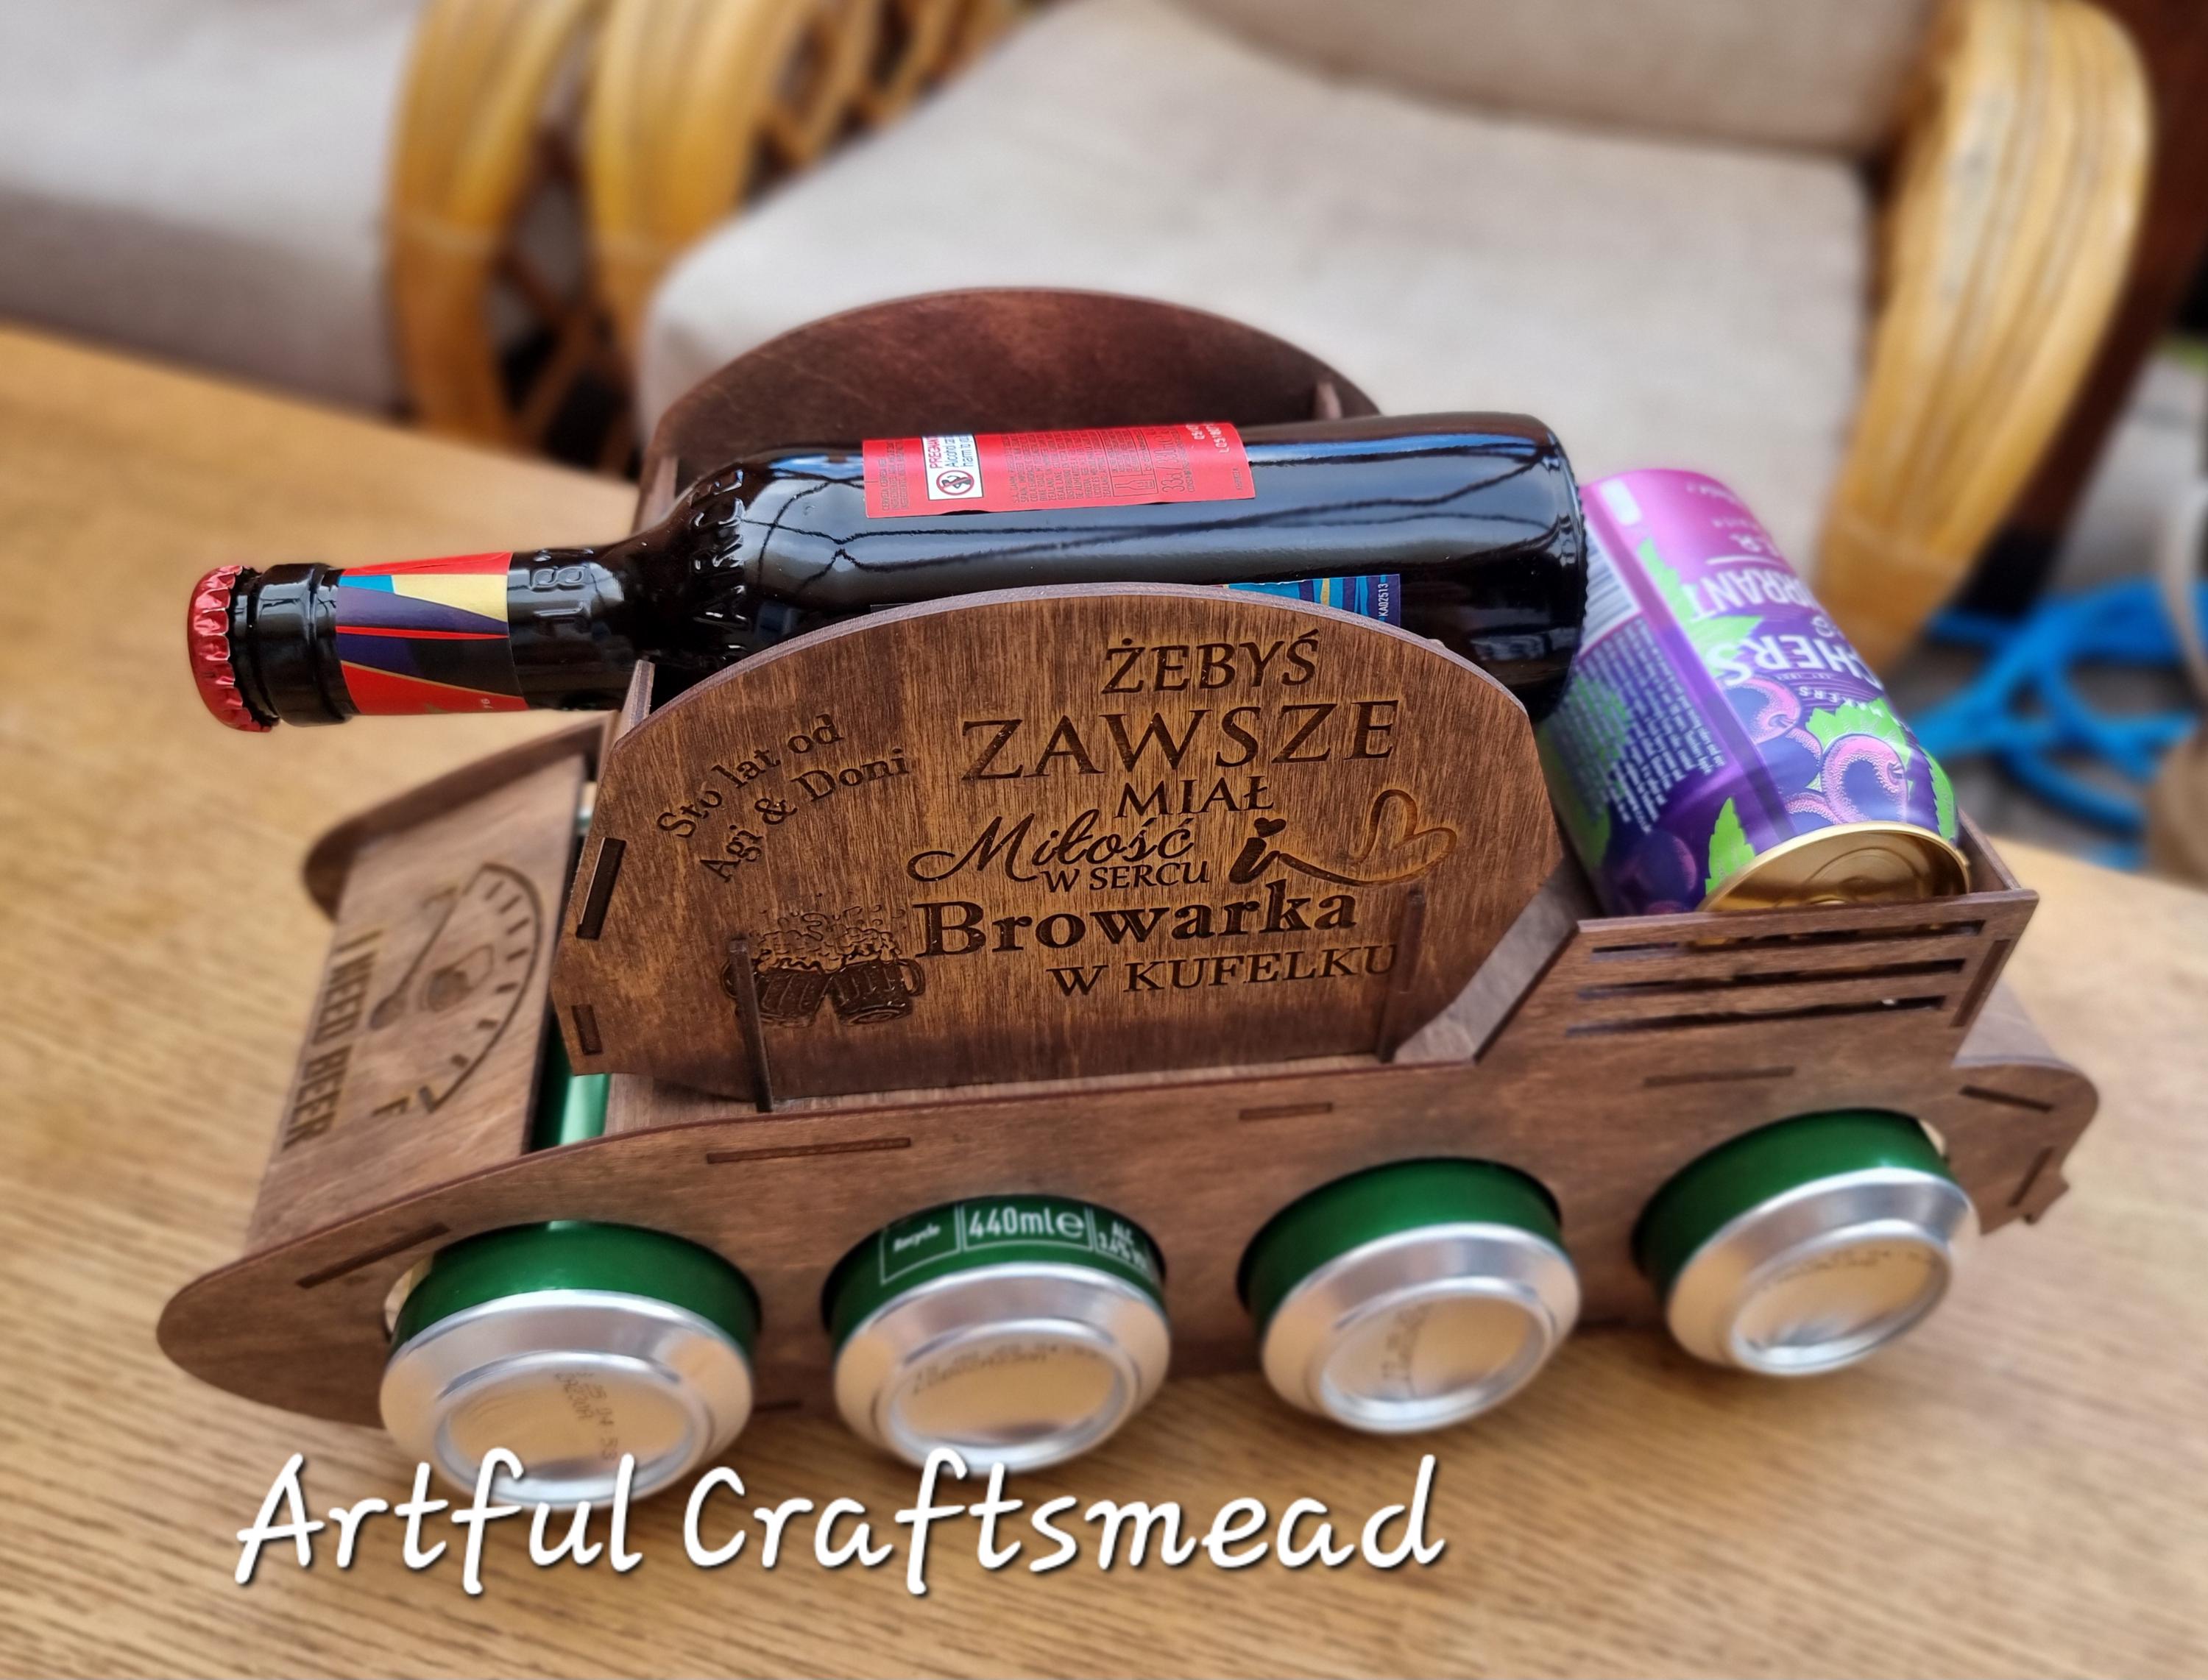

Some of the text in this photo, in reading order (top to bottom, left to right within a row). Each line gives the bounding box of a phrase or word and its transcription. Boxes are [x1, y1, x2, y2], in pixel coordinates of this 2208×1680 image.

[1376, 582, 1390, 617] KA02513
[1102, 628, 1320, 694] ŻEBYŚ
[656, 713, 845, 840] Sto lat od
[961, 699, 1399, 781] ZAWSZE
[698, 747, 910, 882] Agi & Doni
[1114, 776, 1275, 818] MIAŁ
[906, 808, 1196, 883] Miłość
[1089, 860, 1211, 891] SERCU
[913, 879, 1356, 957] Browarka
[1123, 943, 1398, 993] KUFELKU
[281, 1043, 353, 1151] BEER
